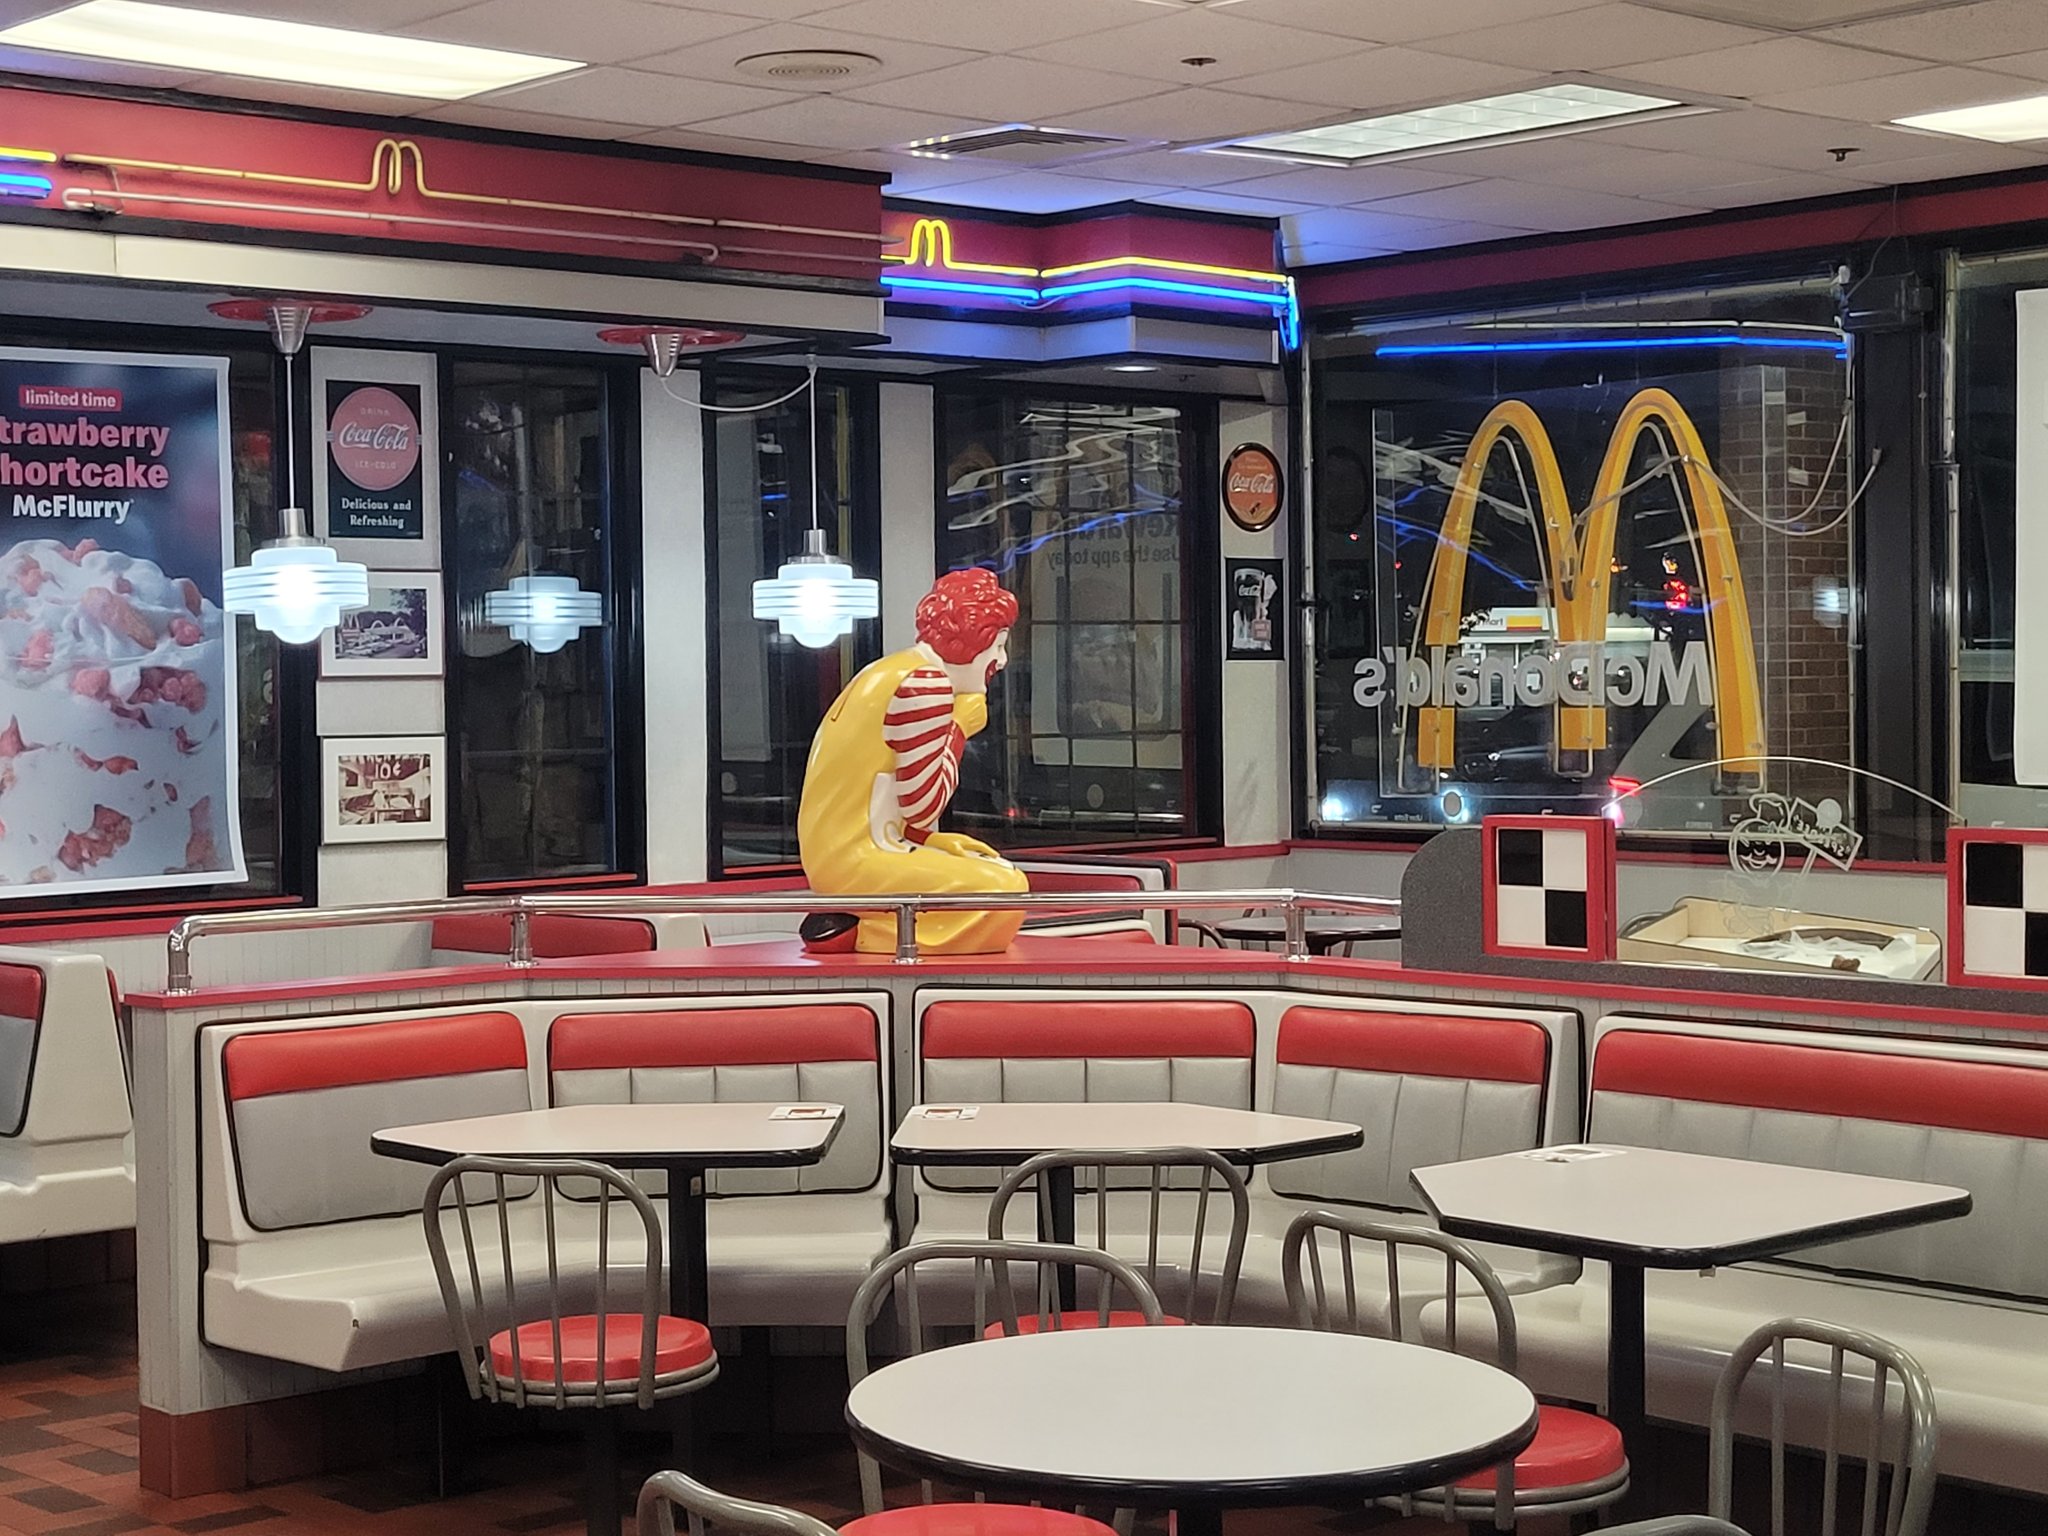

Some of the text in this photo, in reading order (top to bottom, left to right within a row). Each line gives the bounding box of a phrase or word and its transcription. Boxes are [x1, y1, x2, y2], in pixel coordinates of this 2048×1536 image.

[25, 389, 116, 408] limited time
[0, 415, 170, 457] trawberry
[339, 421, 411, 450] Coca-Cola
[0, 452, 169, 489] hortcake
[13, 493, 131, 525] McFlurry
[341, 497, 412, 511] Delicious and
[349, 513, 405, 529] Refreshing
